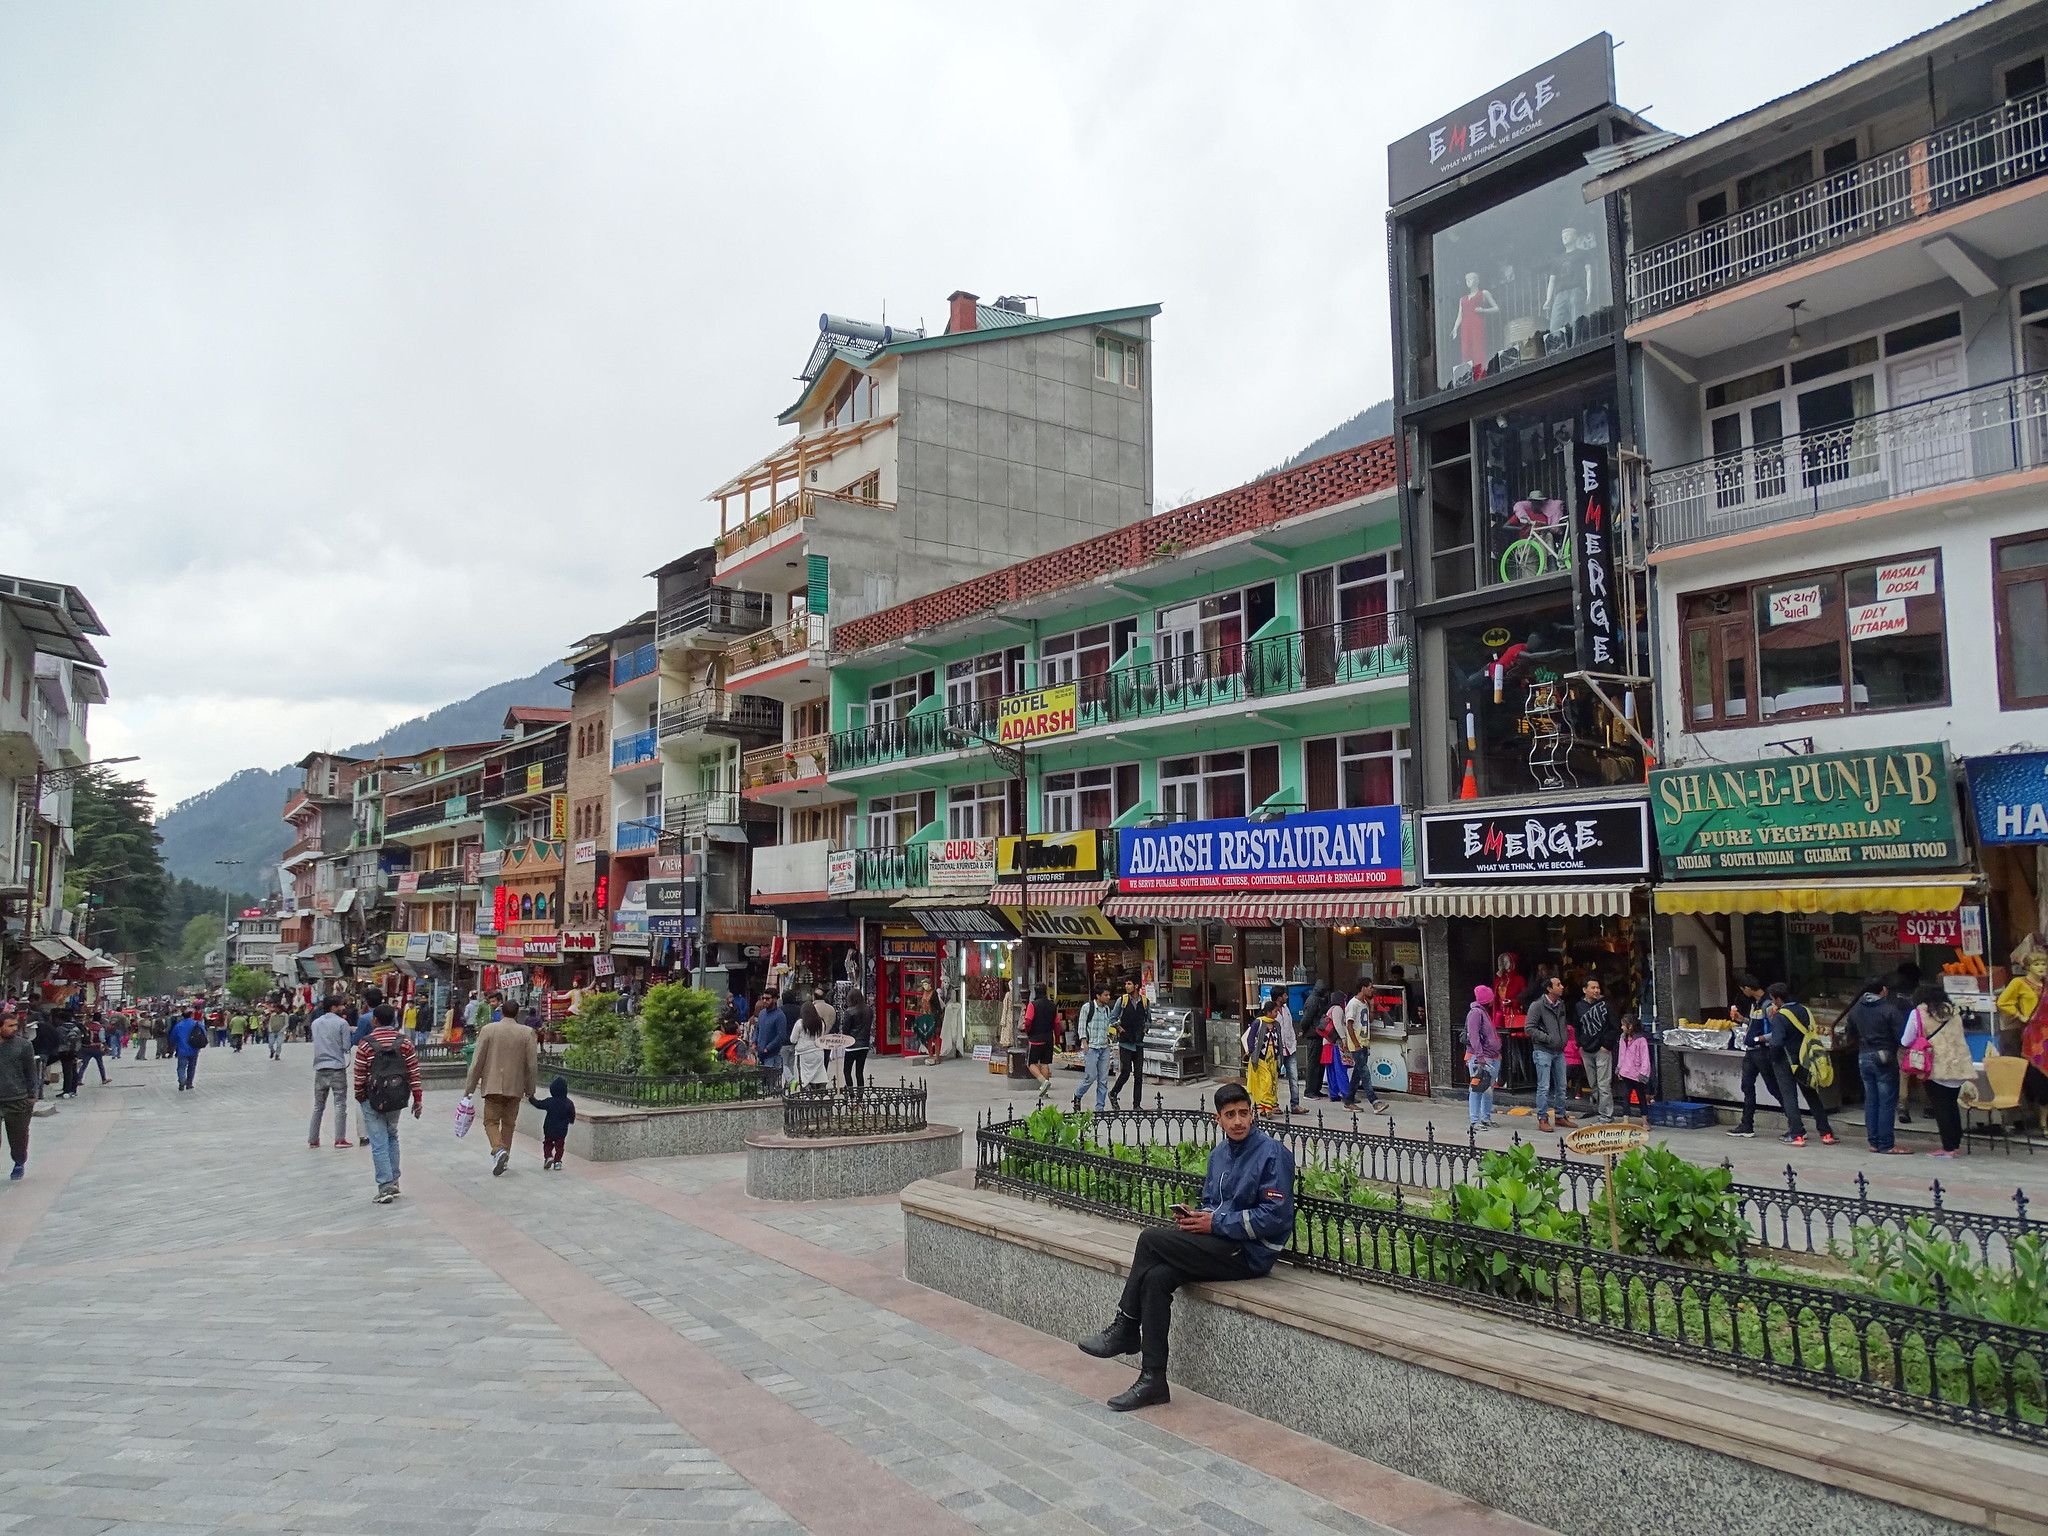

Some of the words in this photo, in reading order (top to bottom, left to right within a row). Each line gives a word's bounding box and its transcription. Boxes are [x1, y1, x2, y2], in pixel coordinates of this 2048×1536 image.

[1440, 158, 1461, 173] WHAT
[1461, 154, 1473, 163] WE
[1498, 136, 1510, 145] WE
[1879, 565, 1927, 581] MASALA
[1885, 581, 1920, 594] DOSA
[1860, 606, 1887, 621] IDLY
[1852, 618, 1906, 635] UTTAPAM
[1000, 694, 1048, 717] HOTEL
[1001, 708, 1074, 741] ADARSH
[1660, 752, 1938, 825] SHAN-E-PUNJAB
[555, 798, 564, 835] RENUKA
[1699, 827, 1753, 848] PURE
[1756, 818, 1902, 844] VEGETARIAN
[576, 846, 594, 859] HOTEL
[945, 841, 976, 861] GURU
[1129, 832, 1213, 874] ADARSH
[1218, 821, 1386, 871] RESTAURANT
[1676, 854, 1712, 870] INDIAN
[1720, 852, 1755, 867] SOUTH
[1757, 850, 1794, 865] INDIAN
[1804, 847, 1851, 864] GUJRATI
[1861, 845, 1910, 861] PUNJABI
[1912, 842, 1947, 858] FOOD
[929, 863, 956, 871] TRADITIONAL
[984, 861, 994, 869] SPA
[1476, 864, 1497, 872] WHAT
[1498, 863, 1510, 871] WE
[1510, 862, 1536, 872] THINK,
[1537, 862, 1549, 870] WE
[1550, 860, 1586, 869] BECOME.
[1037, 873, 1051, 881] FOTO
[1051, 872, 1065, 881] FIRST
[1129, 880, 1138, 888] WE
[1138, 879, 1155, 888] SERVE
[1180, 877, 1199, 887] SOUTH
[1297, 873, 1326, 884] GUJRATI
[1327, 873, 1333, 883] &
[1334, 872, 1364, 882] BENGALI
[1366, 871, 1387, 882] FOOD
[1016, 909, 1103, 935] Nikon
[1906, 919, 1958, 937] SOFTY
[524, 942, 556, 953] SATYAM
[891, 941, 907, 952] TIBET
[1919, 935, 1933, 944] Rs.
[501, 976, 522, 989] SOFTY
